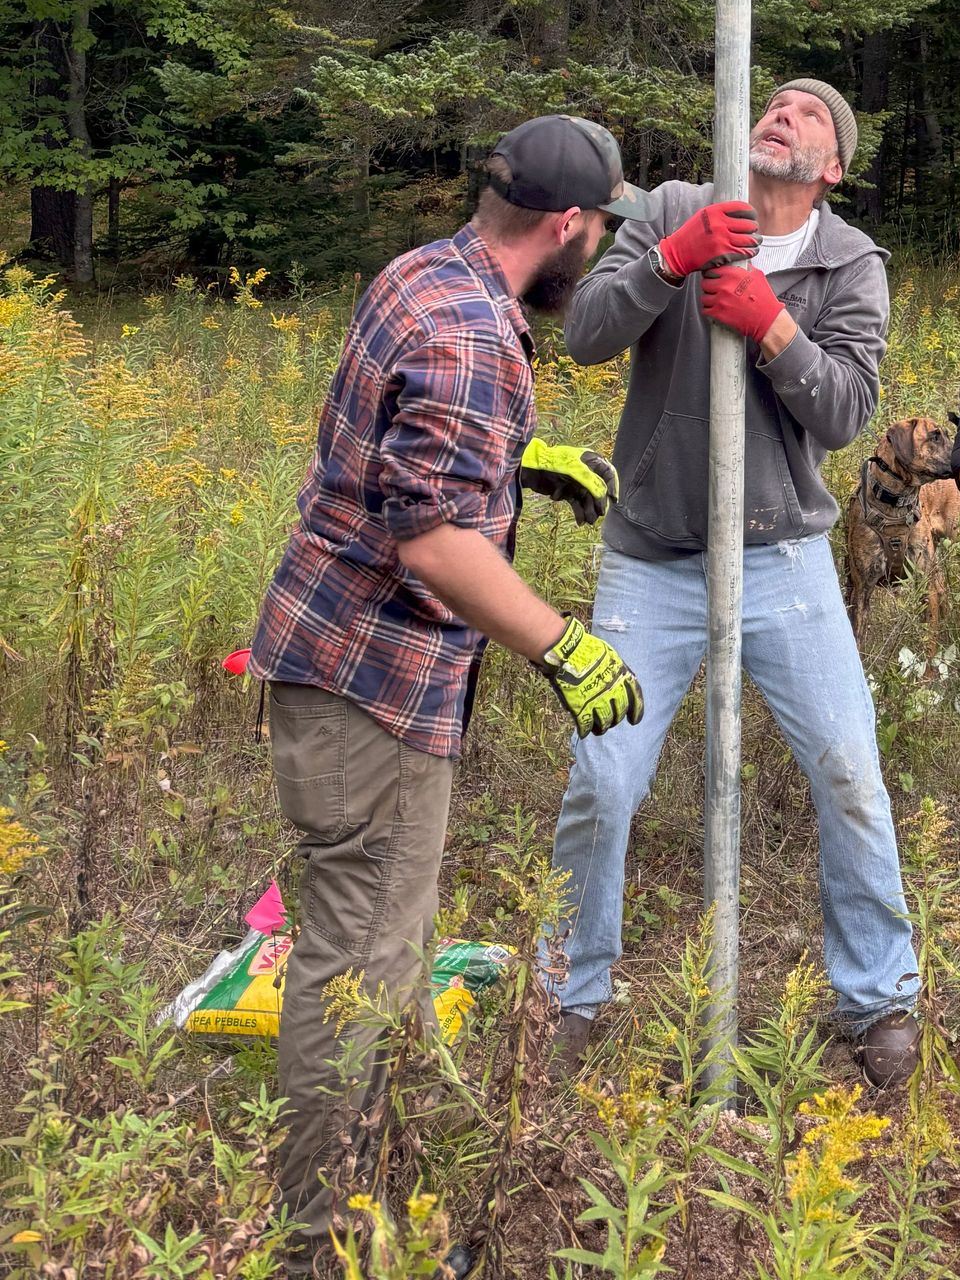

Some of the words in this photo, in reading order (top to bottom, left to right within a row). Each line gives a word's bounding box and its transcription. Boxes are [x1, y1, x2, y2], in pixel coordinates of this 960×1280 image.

[258, 937, 292, 969] Vigo
[193, 1017, 211, 1026] PEA
[214, 1017, 257, 1028] PEBBLES
